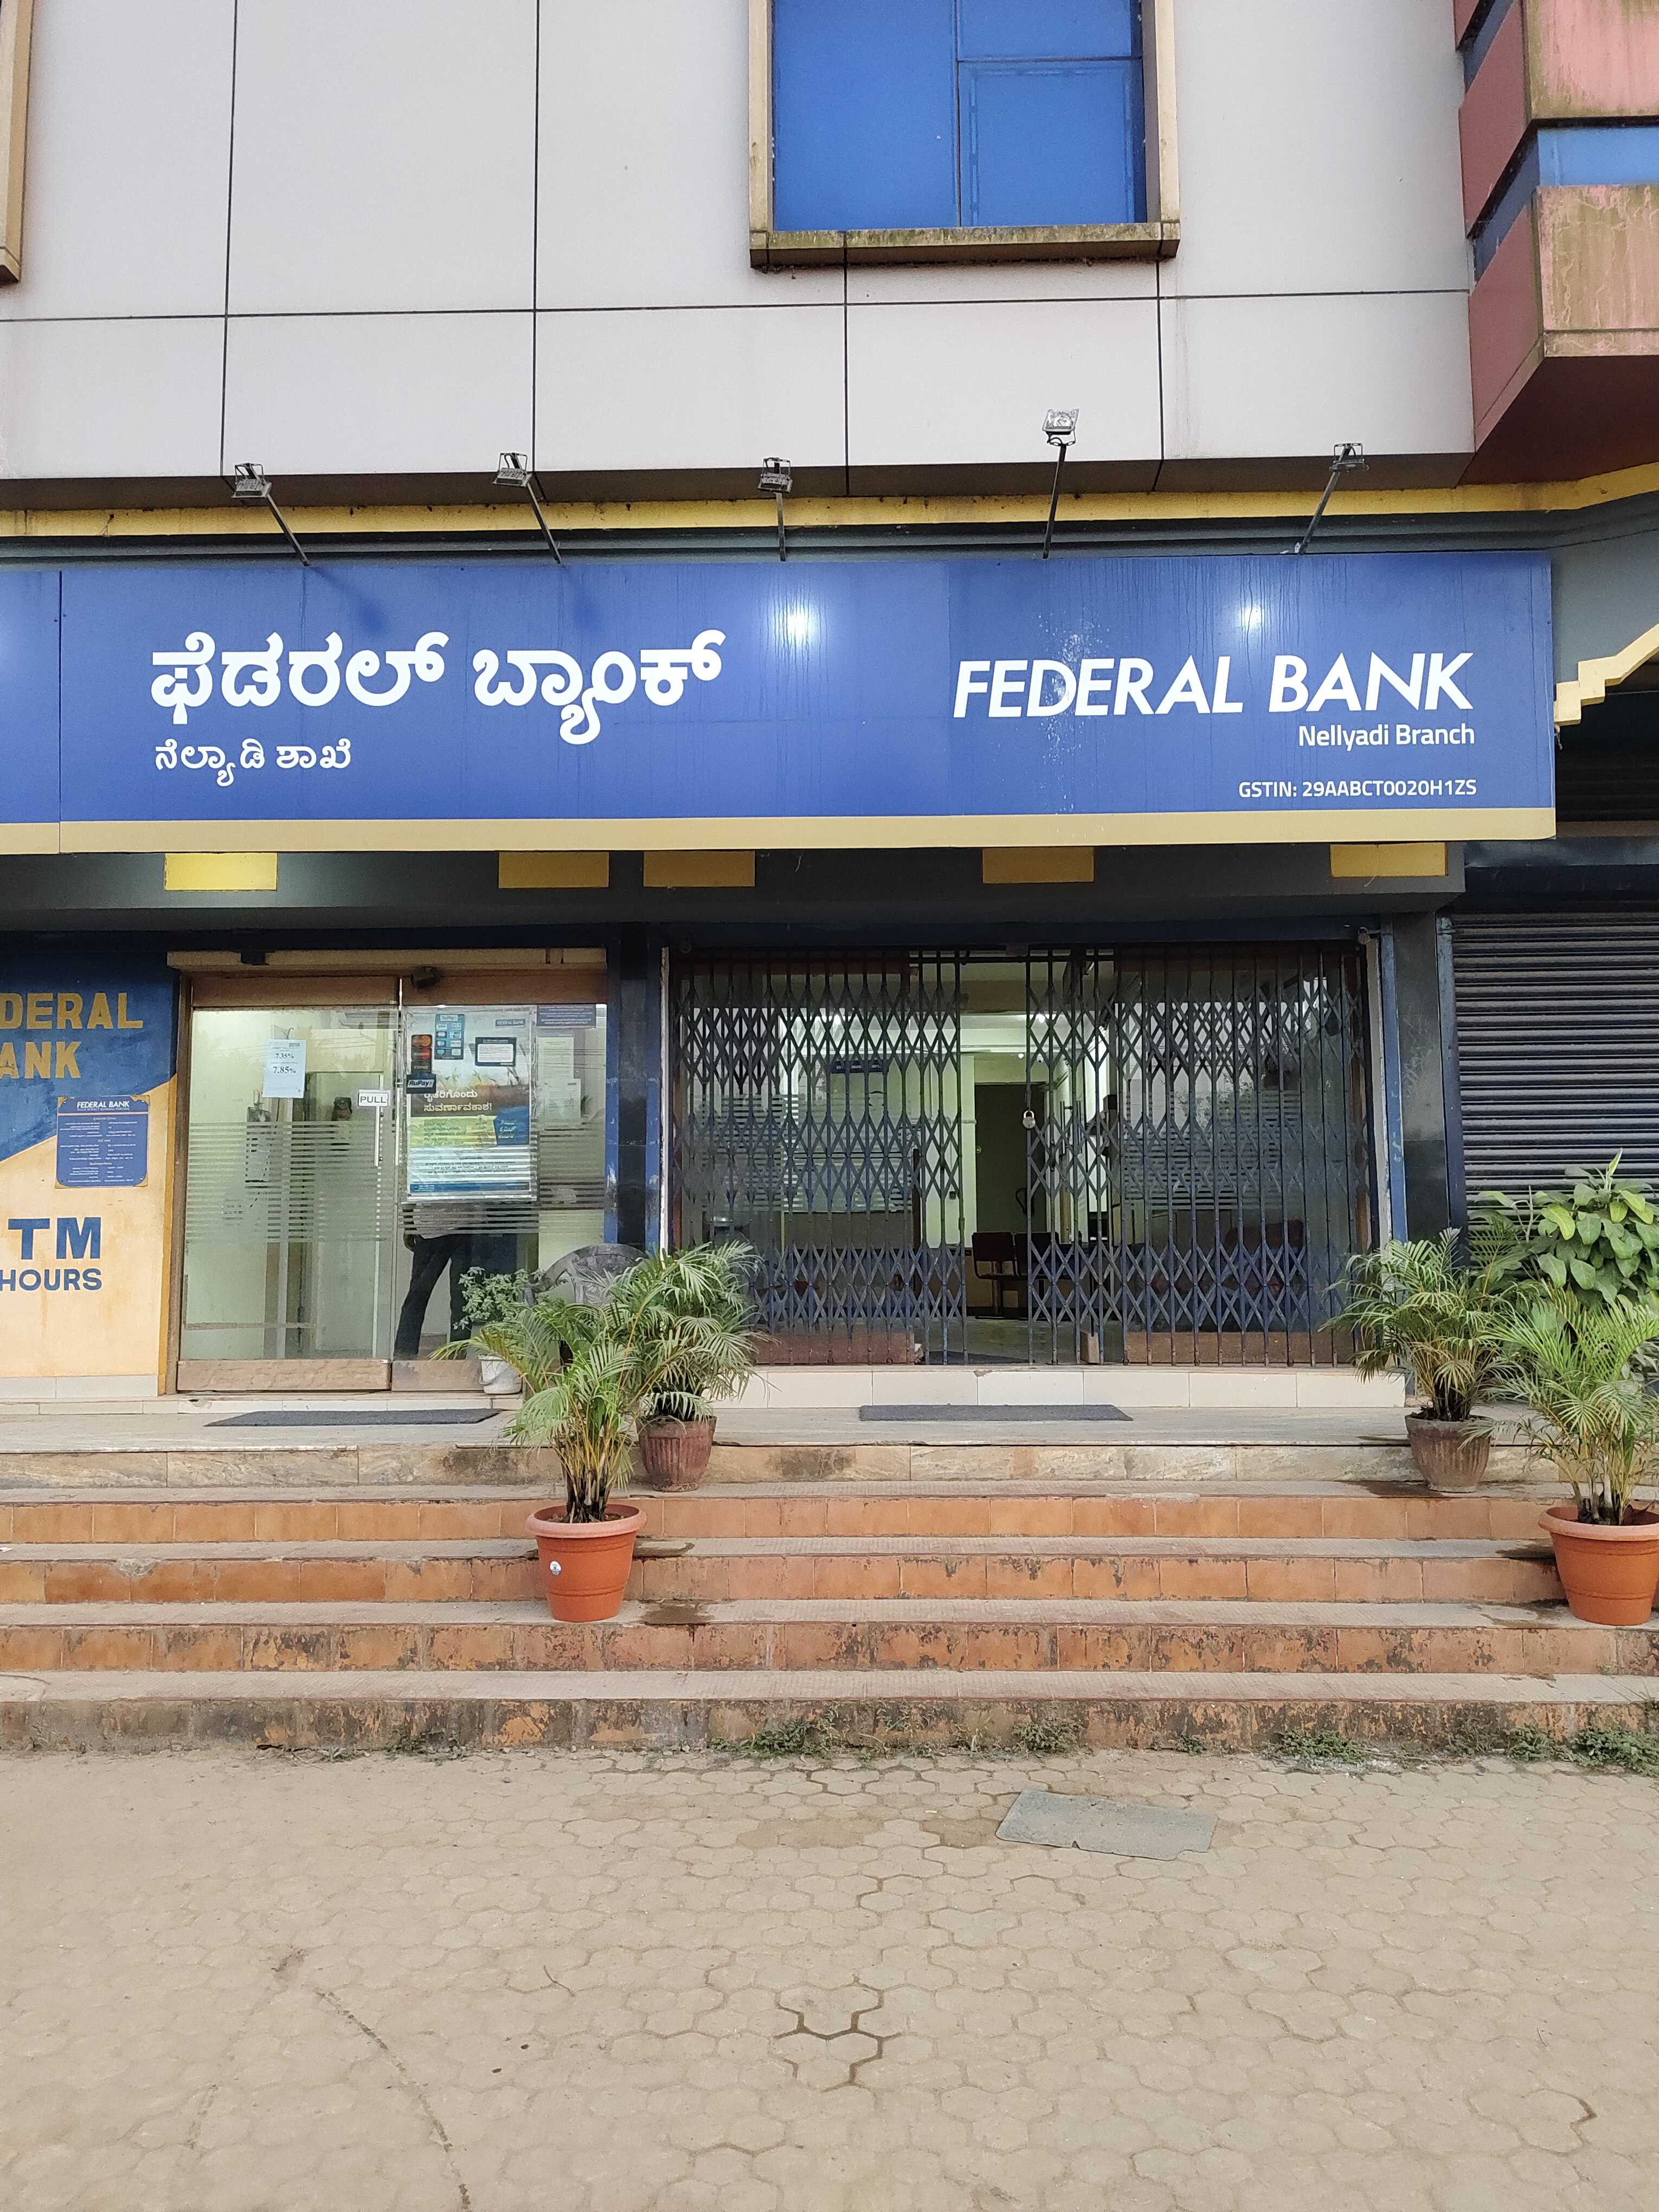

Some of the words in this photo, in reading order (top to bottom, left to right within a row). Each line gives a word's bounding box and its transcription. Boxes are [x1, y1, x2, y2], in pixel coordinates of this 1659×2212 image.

[151, 632, 449, 725] ಫೆಡರಲ್
[472, 629, 726, 745] ಬ್ಯಾಂಕ್
[953, 654, 1244, 718] FEDERAL
[1268, 652, 1474, 713] BANK
[1298, 723, 1389, 751] Nellyadi
[1396, 723, 1475, 745] Branch
[155, 738, 266, 787] ನೆಲ್ಯಾಡಿ
[275, 738, 351, 769] ಶಾಖೆ
[1238, 781, 1297, 798] GSTIN:
[1302, 779, 1477, 797] 29AABCT0020H1ZS
[0, 1268, 102, 1291] HOURS
